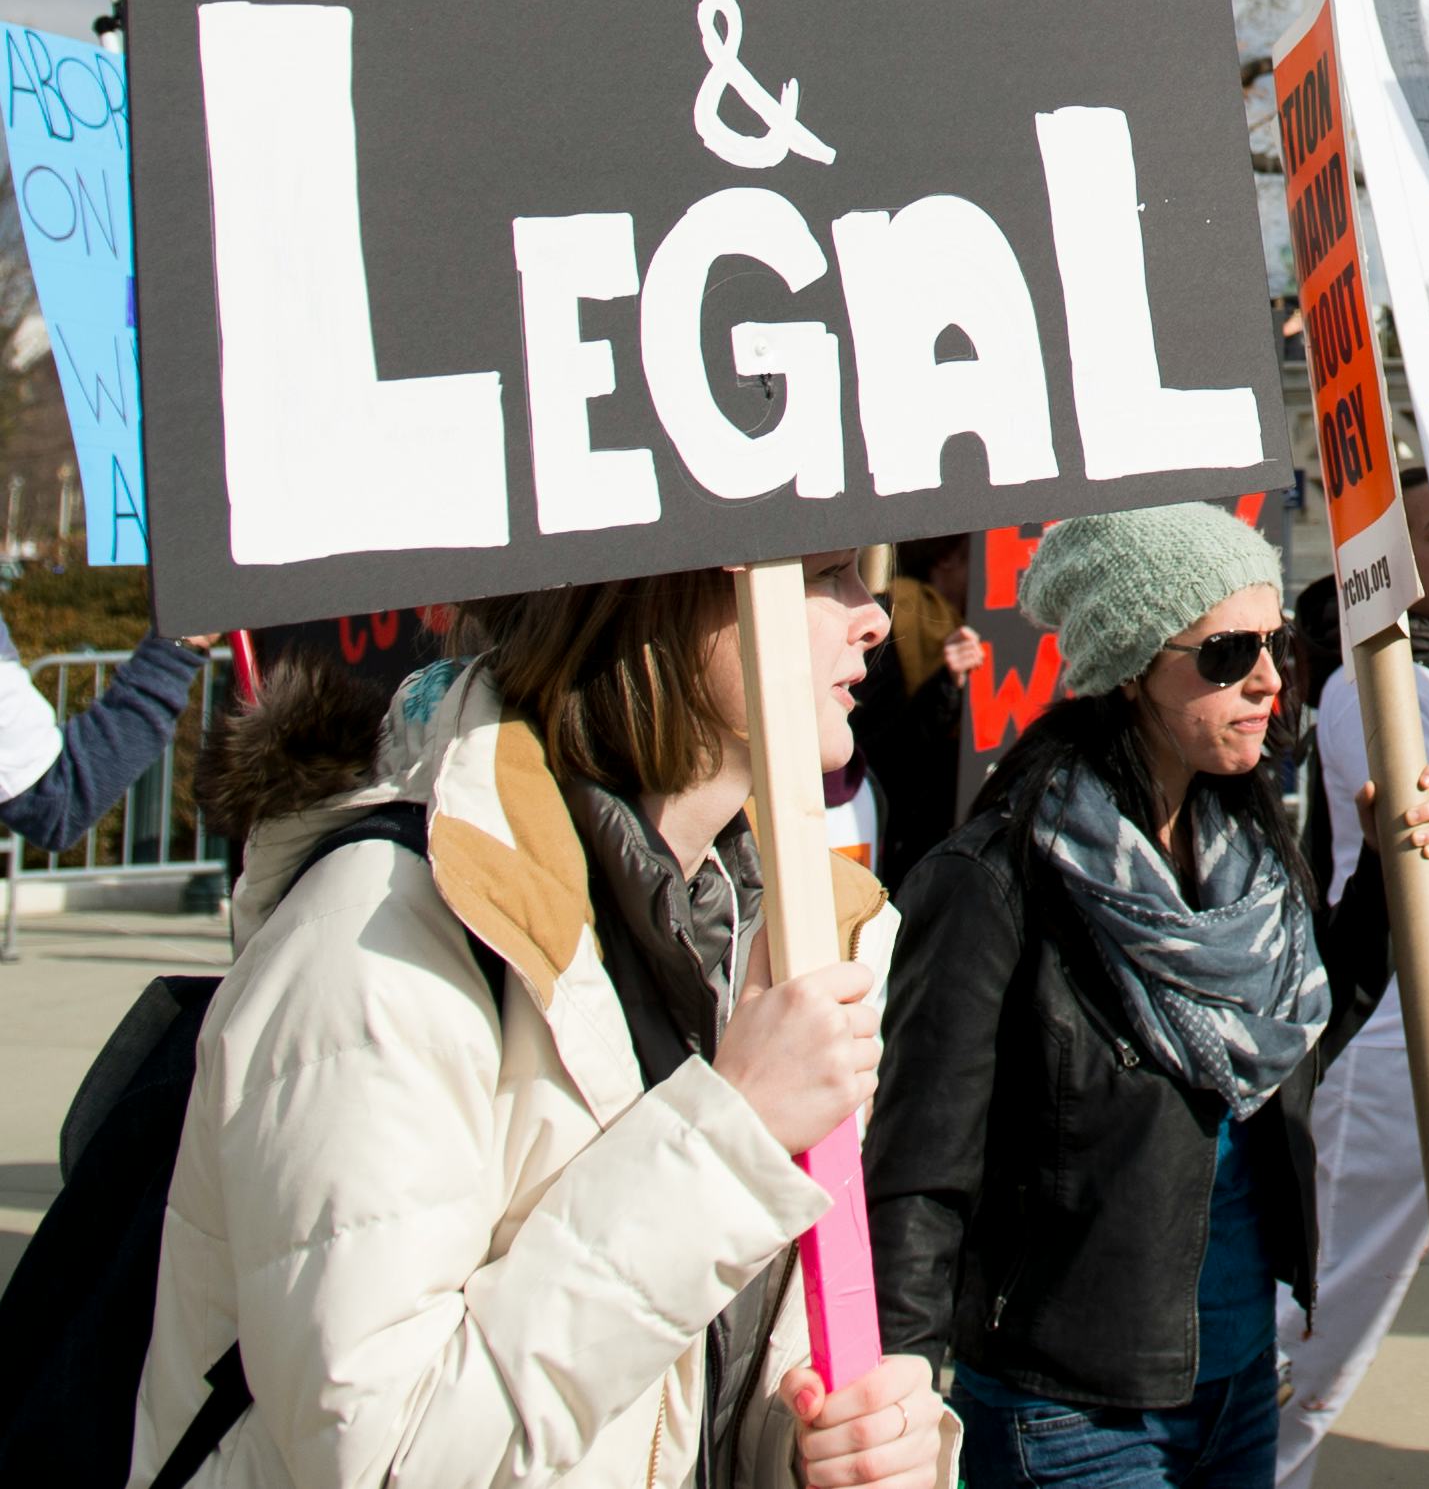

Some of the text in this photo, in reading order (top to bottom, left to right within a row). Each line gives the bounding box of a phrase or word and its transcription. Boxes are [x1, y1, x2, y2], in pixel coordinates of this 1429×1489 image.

[6, 28, 130, 150] ABOR
[1278, 50, 1333, 179] TION
[23, 165, 118, 259] ON
[1291, 151, 1348, 282] MAND
[198, 1, 1263, 565] LEGAL
[1306, 261, 1364, 393] HOUT
[1323, 382, 1374, 500] OGY
[1343, 555, 1391, 611] rchy.org
